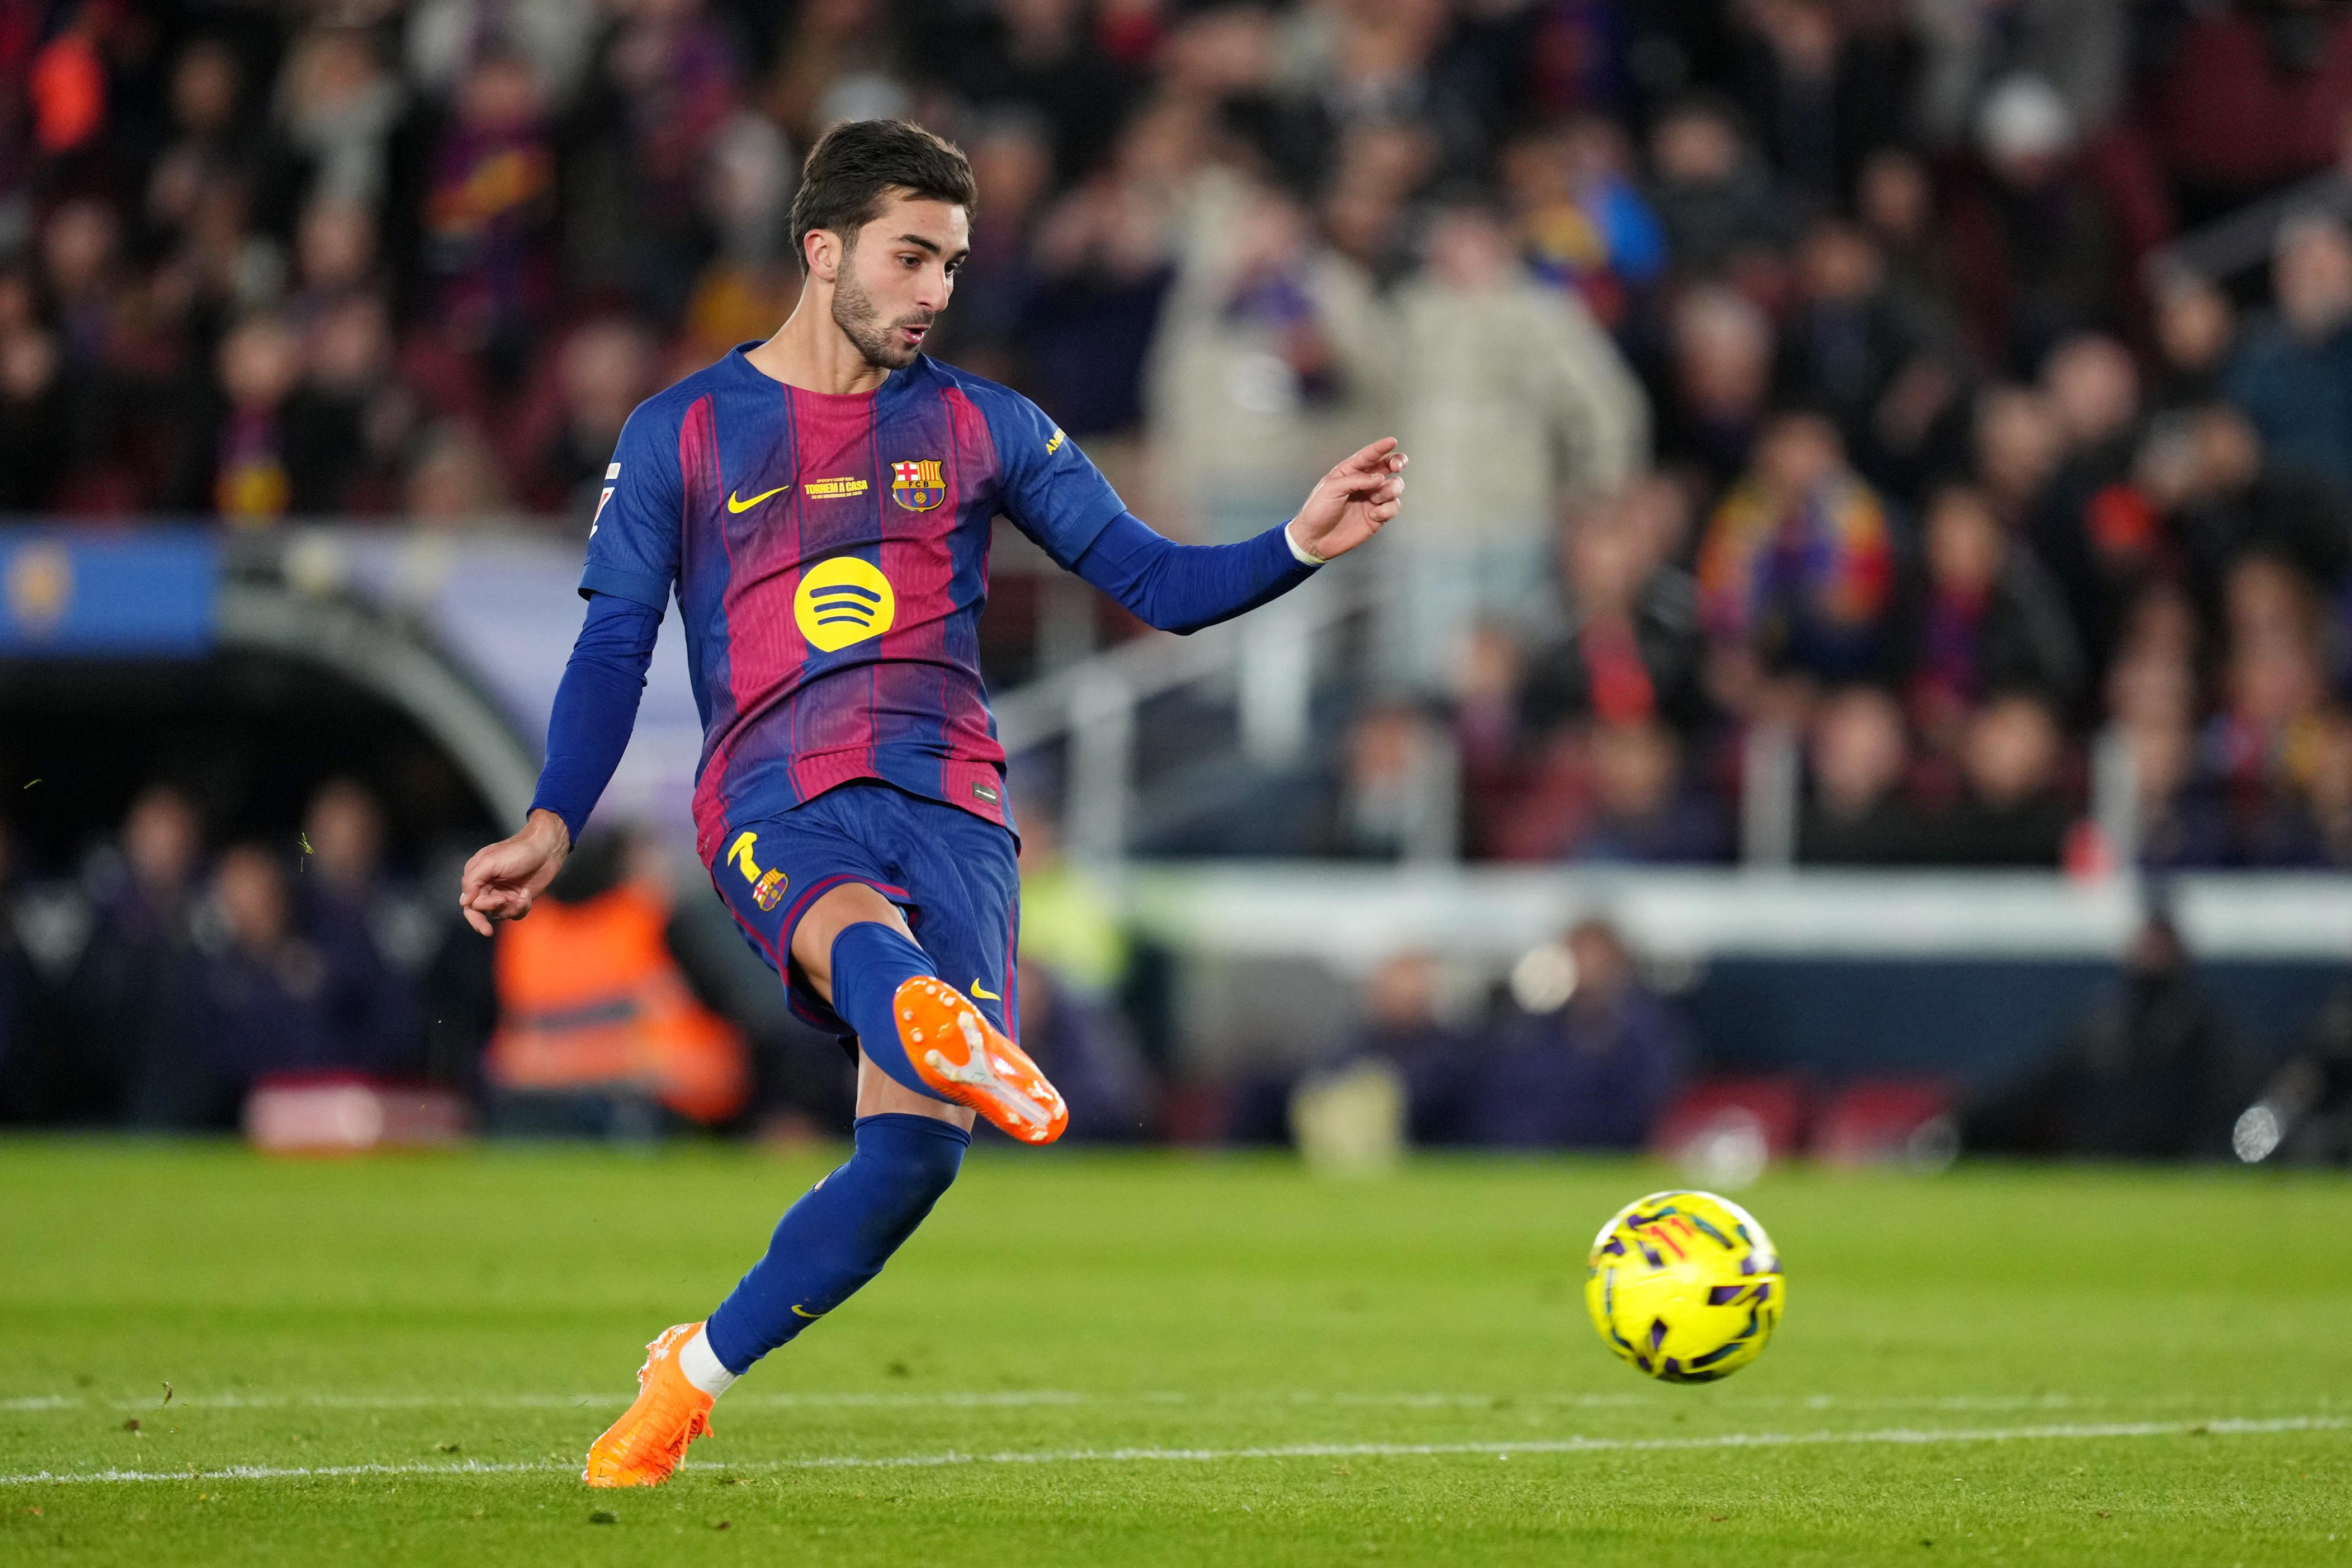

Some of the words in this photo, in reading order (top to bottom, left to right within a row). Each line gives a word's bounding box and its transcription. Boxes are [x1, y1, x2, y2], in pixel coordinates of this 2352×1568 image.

[804, 482, 839, 495] TORNEM
[839, 481, 846, 493] A
[846, 480, 868, 492] CASA
